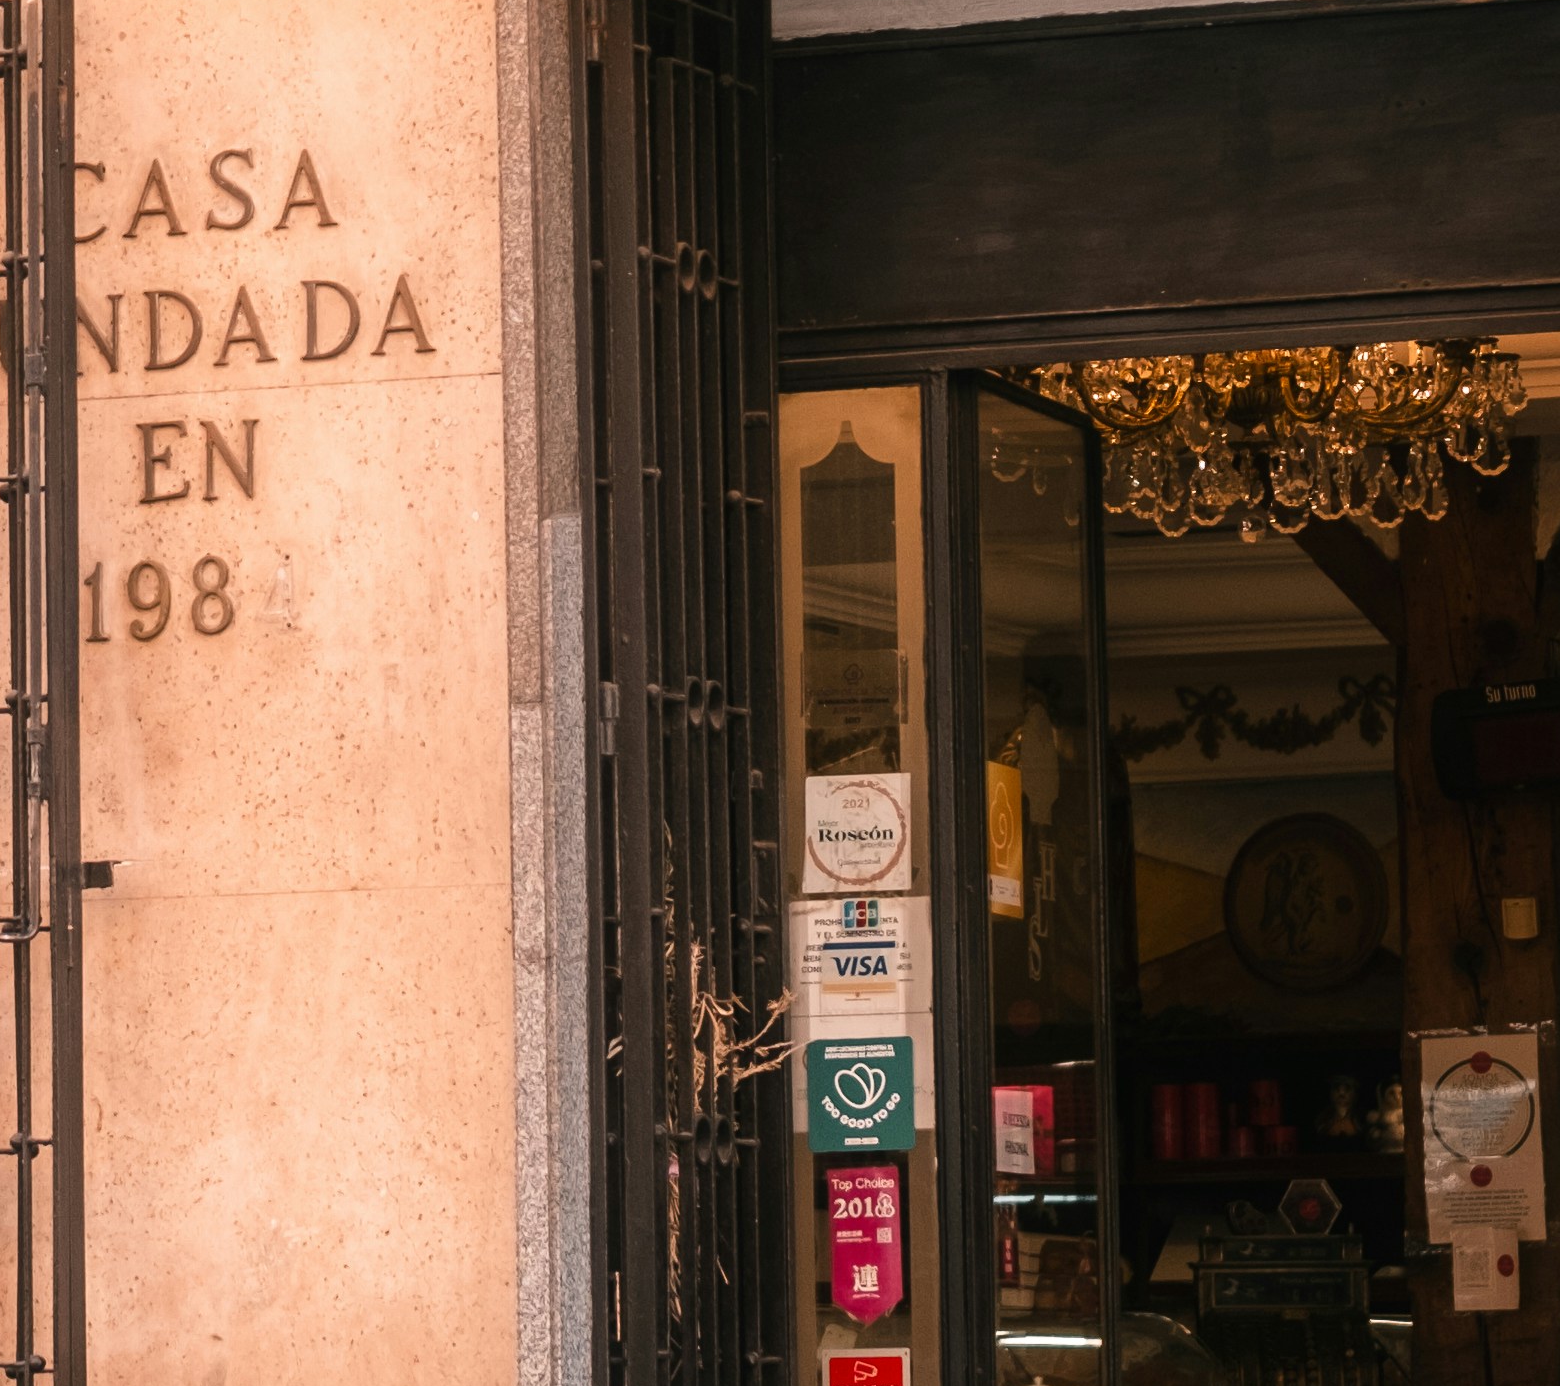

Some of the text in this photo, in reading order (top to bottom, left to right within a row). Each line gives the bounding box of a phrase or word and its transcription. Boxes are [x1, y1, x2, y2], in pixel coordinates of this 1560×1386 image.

[73, 148, 338, 243] CASA
[137, 419, 260, 504] EN
[1485, 683, 1537, 703] Su turno
[842, 798, 870, 810] 2021
[818, 824, 894, 843] Roscón
[830, 955, 888, 976] VISA
[821, 1092, 901, 1129] TOO GOOD TO GO
[831, 1176, 895, 1190] Top Choice
[833, 1193, 896, 1219] 2018
